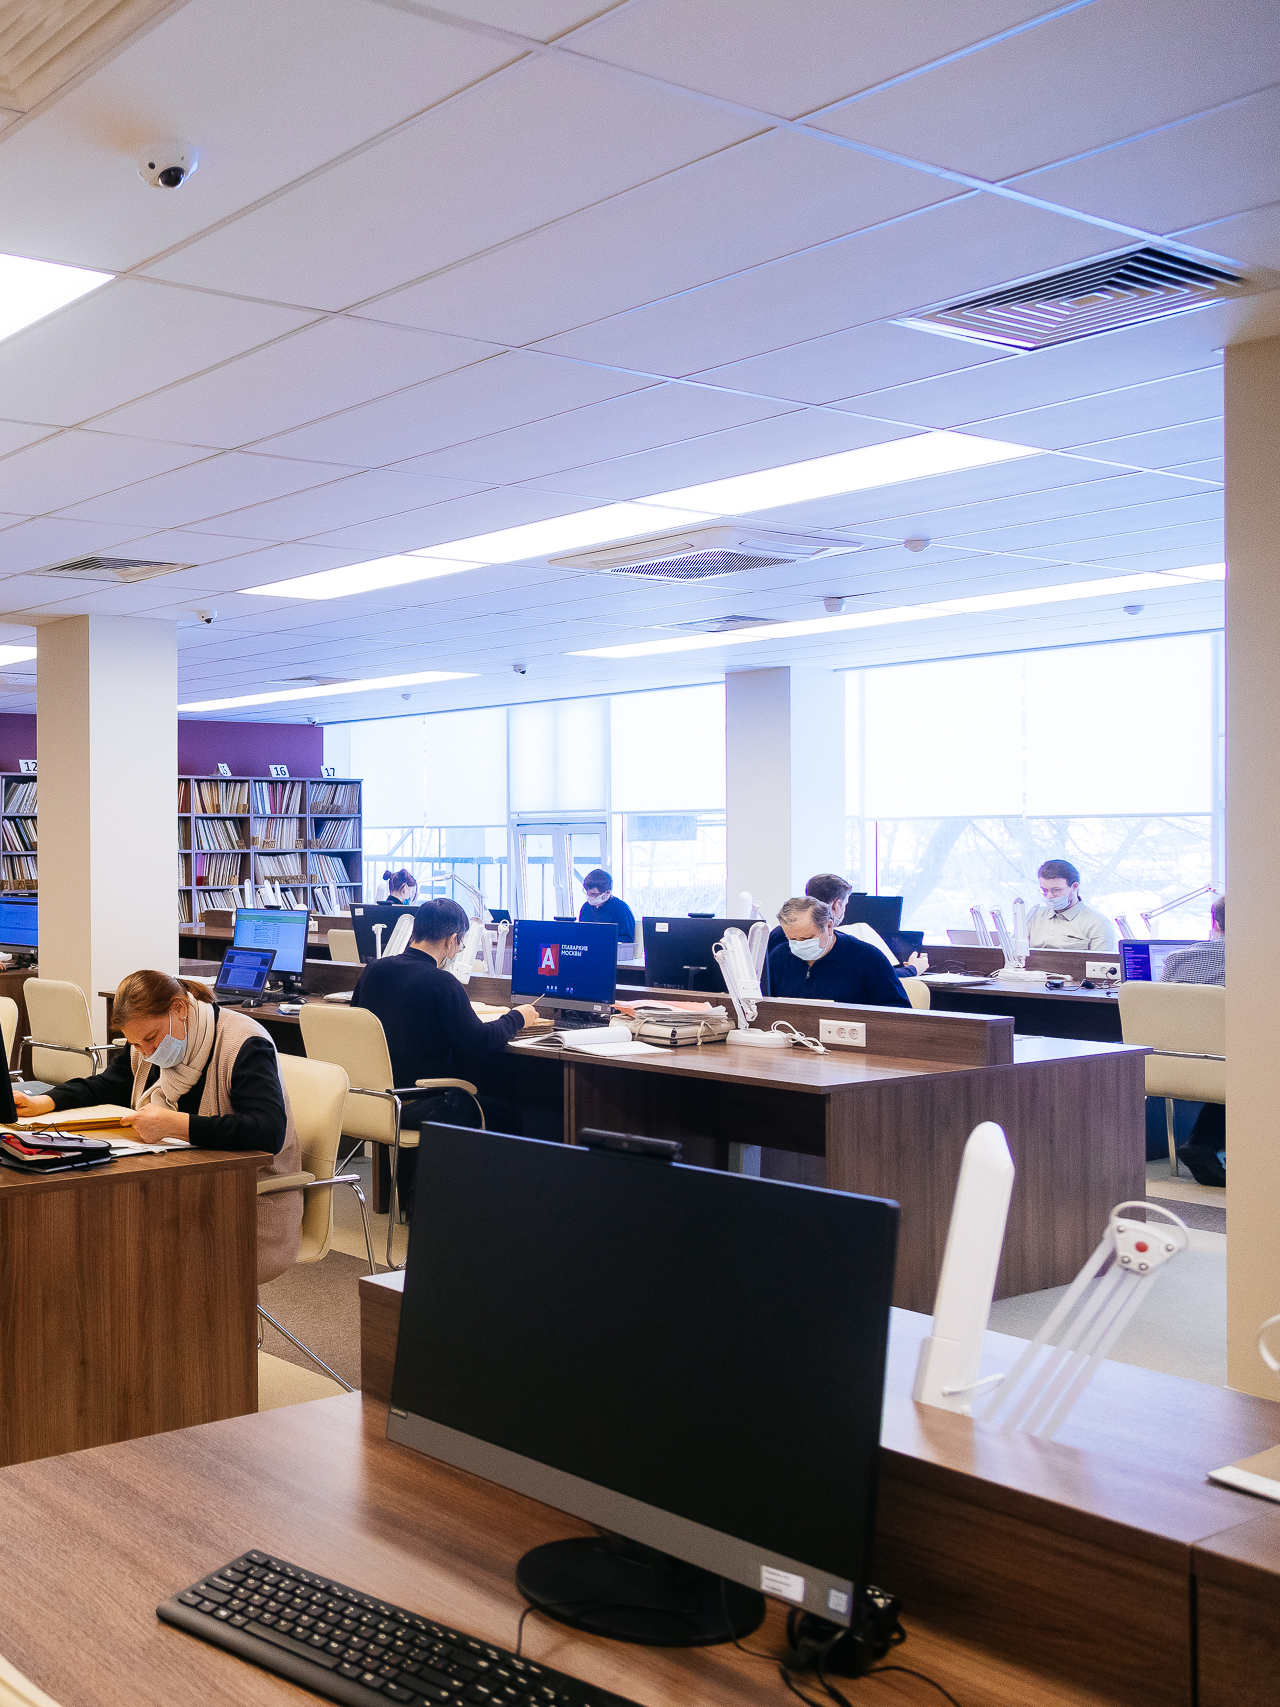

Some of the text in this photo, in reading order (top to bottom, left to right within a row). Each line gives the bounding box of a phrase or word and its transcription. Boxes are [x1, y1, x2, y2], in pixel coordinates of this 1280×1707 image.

[24, 761, 38, 772] 12
[273, 766, 287, 776] 16
[324, 767, 336, 777] 17
